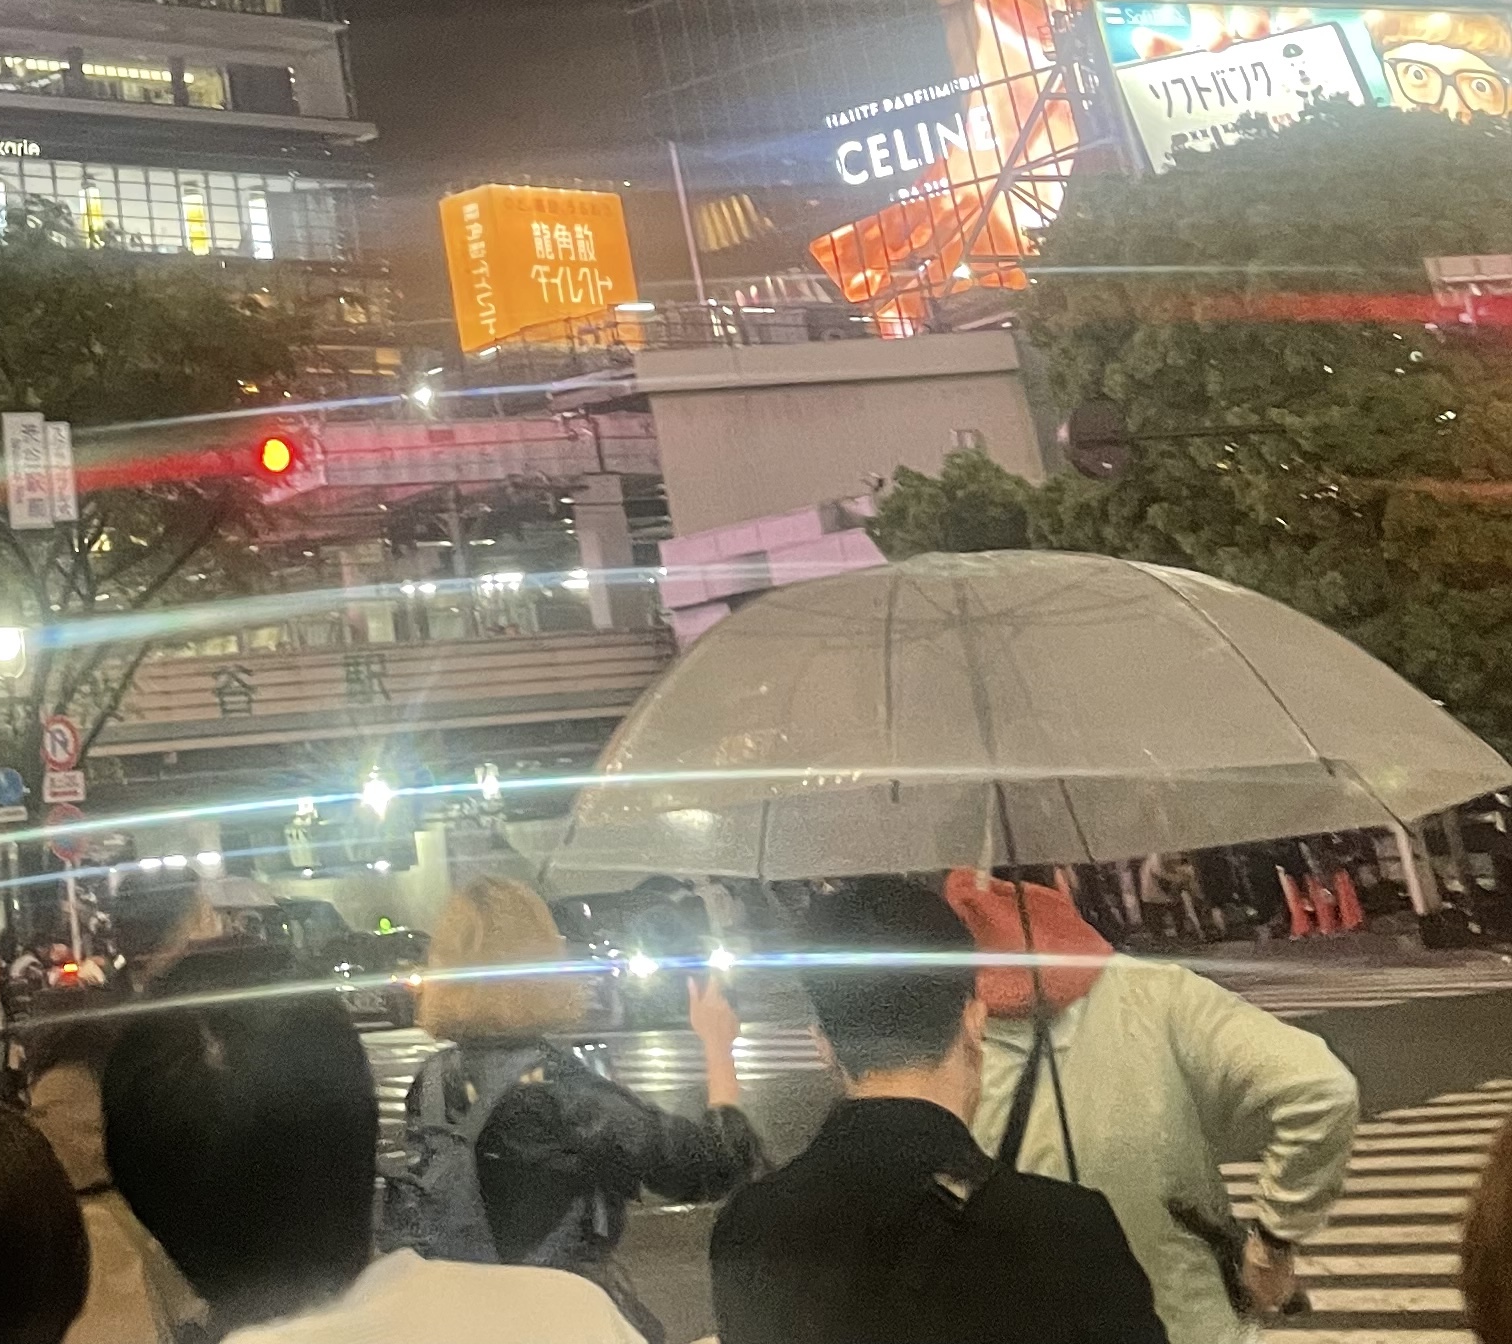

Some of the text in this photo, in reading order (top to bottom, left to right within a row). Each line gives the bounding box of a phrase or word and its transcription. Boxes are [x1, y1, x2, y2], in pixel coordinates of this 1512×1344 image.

[1149, 62, 1272, 119] ソフトバンク
[836, 106, 998, 185] CELINE
[530, 221, 596, 262] 龍角散
